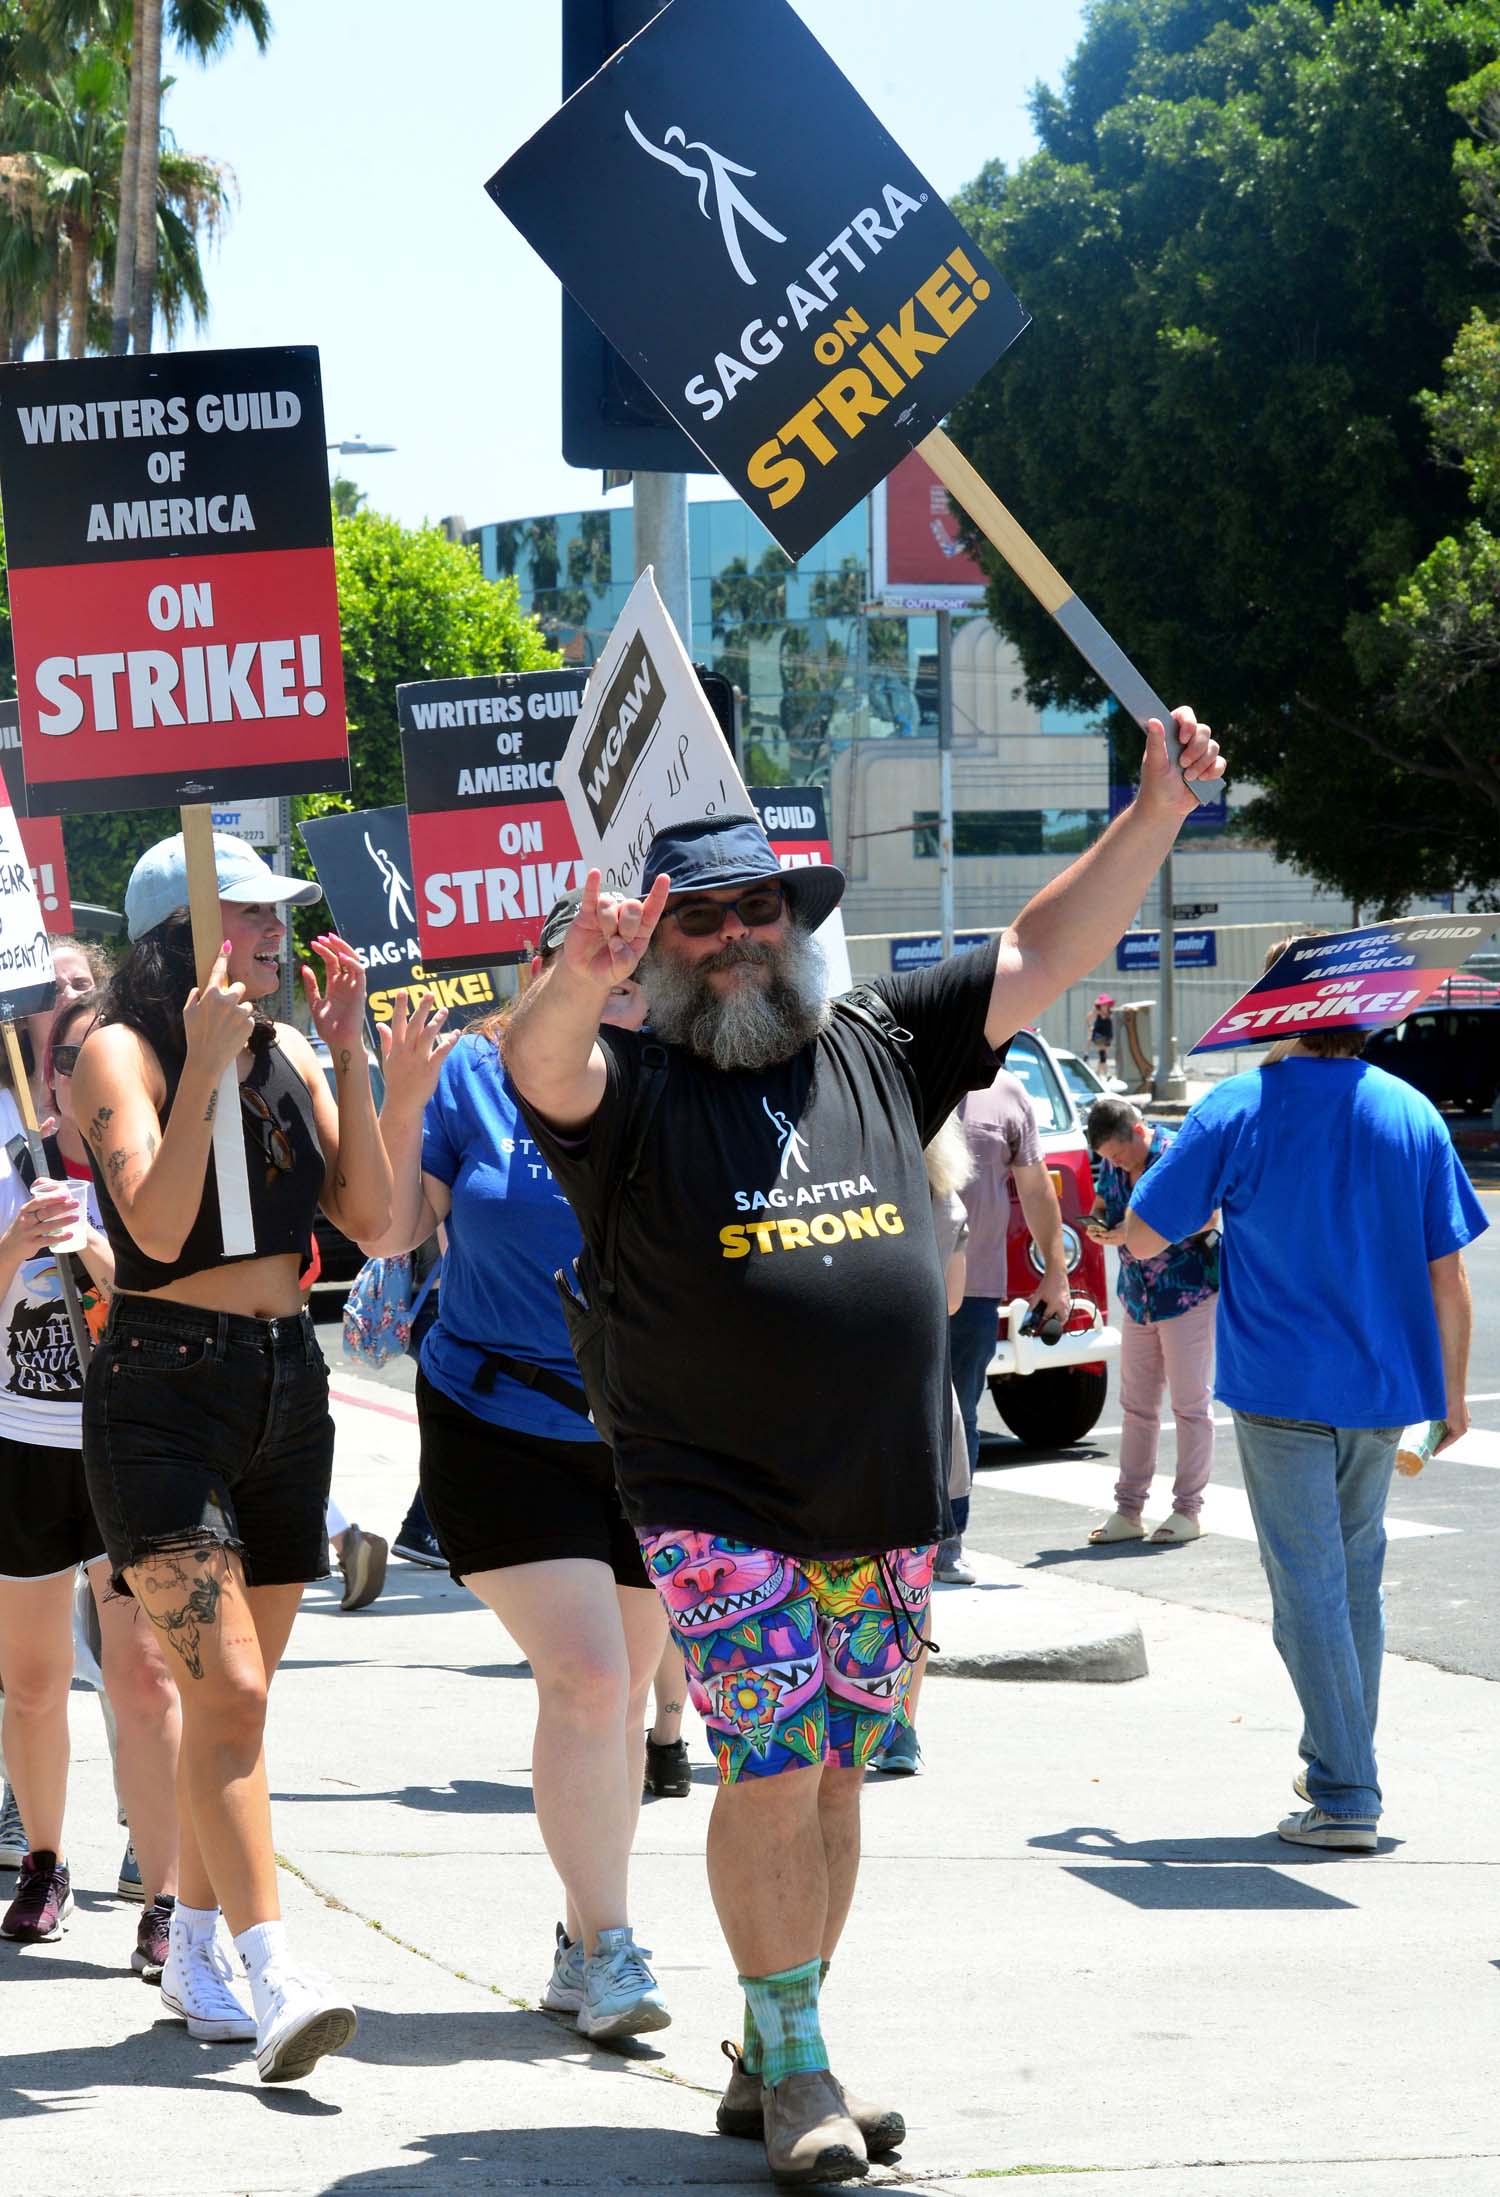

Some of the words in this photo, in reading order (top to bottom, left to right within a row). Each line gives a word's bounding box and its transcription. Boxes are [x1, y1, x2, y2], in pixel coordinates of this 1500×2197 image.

[814, 306, 870, 365] ON
[747, 246, 990, 510] STRIKE!
[17, 397, 189, 444] WRITERS
[196, 391, 301, 431] GUILD
[147, 451, 186, 484] OF
[87, 494, 256, 542] AMERICA
[147, 582, 214, 631] ON
[35, 634, 326, 736] STRIKE!
[411, 695, 525, 730] WRITERS
[527, 690, 586, 720] GUIL
[496, 732, 523, 755] OF
[586, 655, 652, 807] WGAW
[667, 734, 690, 798] UP
[499, 821, 544, 855] ON
[764, 806, 816, 830] GUILD
[354, 938, 422, 970] SAG·A
[1293, 931, 1403, 962] WRITERS
[1407, 927, 1482, 941] GUILD
[1359, 947, 1389, 959] OF
[1302, 955, 1416, 981] AMERICA
[1316, 980, 1365, 997] ON
[1218, 990, 1420, 1034] STRIKE!
[734, 1174, 876, 1212] SAG·AFTRA
[718, 1203, 905, 1258] STRONG
